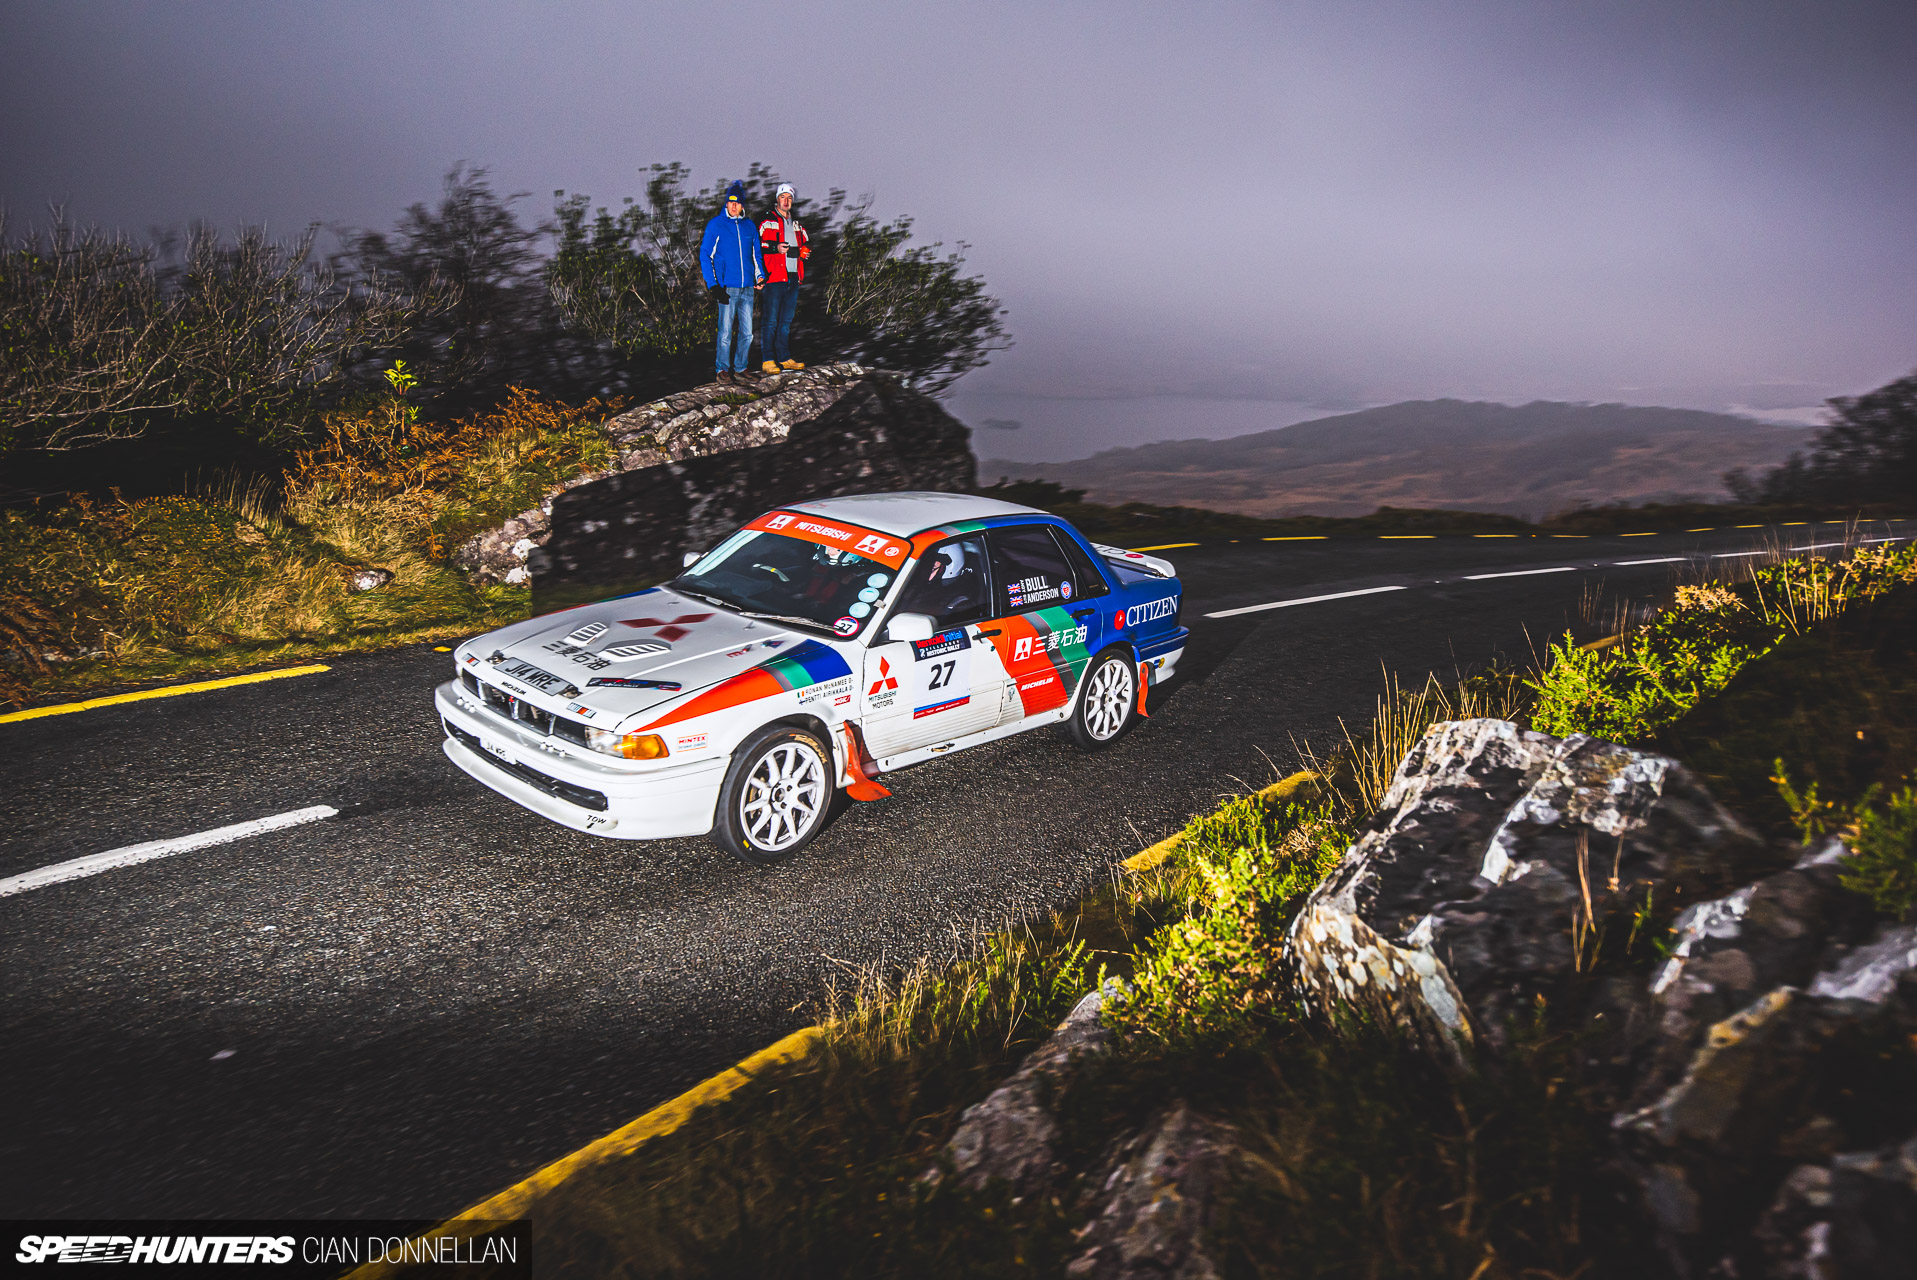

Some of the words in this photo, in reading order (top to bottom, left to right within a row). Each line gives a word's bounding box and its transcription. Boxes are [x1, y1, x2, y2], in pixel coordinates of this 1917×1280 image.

[794, 521, 852, 541] MITSUBISHI
[1024, 575, 1049, 592] BULL
[1027, 587, 1060, 604] ANDERSON
[1125, 594, 1179, 627] CITIZEN
[1033, 623, 1088, 655] 三菱石油
[541, 640, 613, 671] 三菱石油
[524, 667, 561, 690] WRE
[928, 660, 957, 690] 27
[1021, 677, 1054, 691] MICHELIN
[868, 690, 897, 702] MITSUBISHI
[872, 698, 894, 709] MOTORS
[679, 736, 706, 744] MINTEX
[587, 814, 607, 824] TOW
